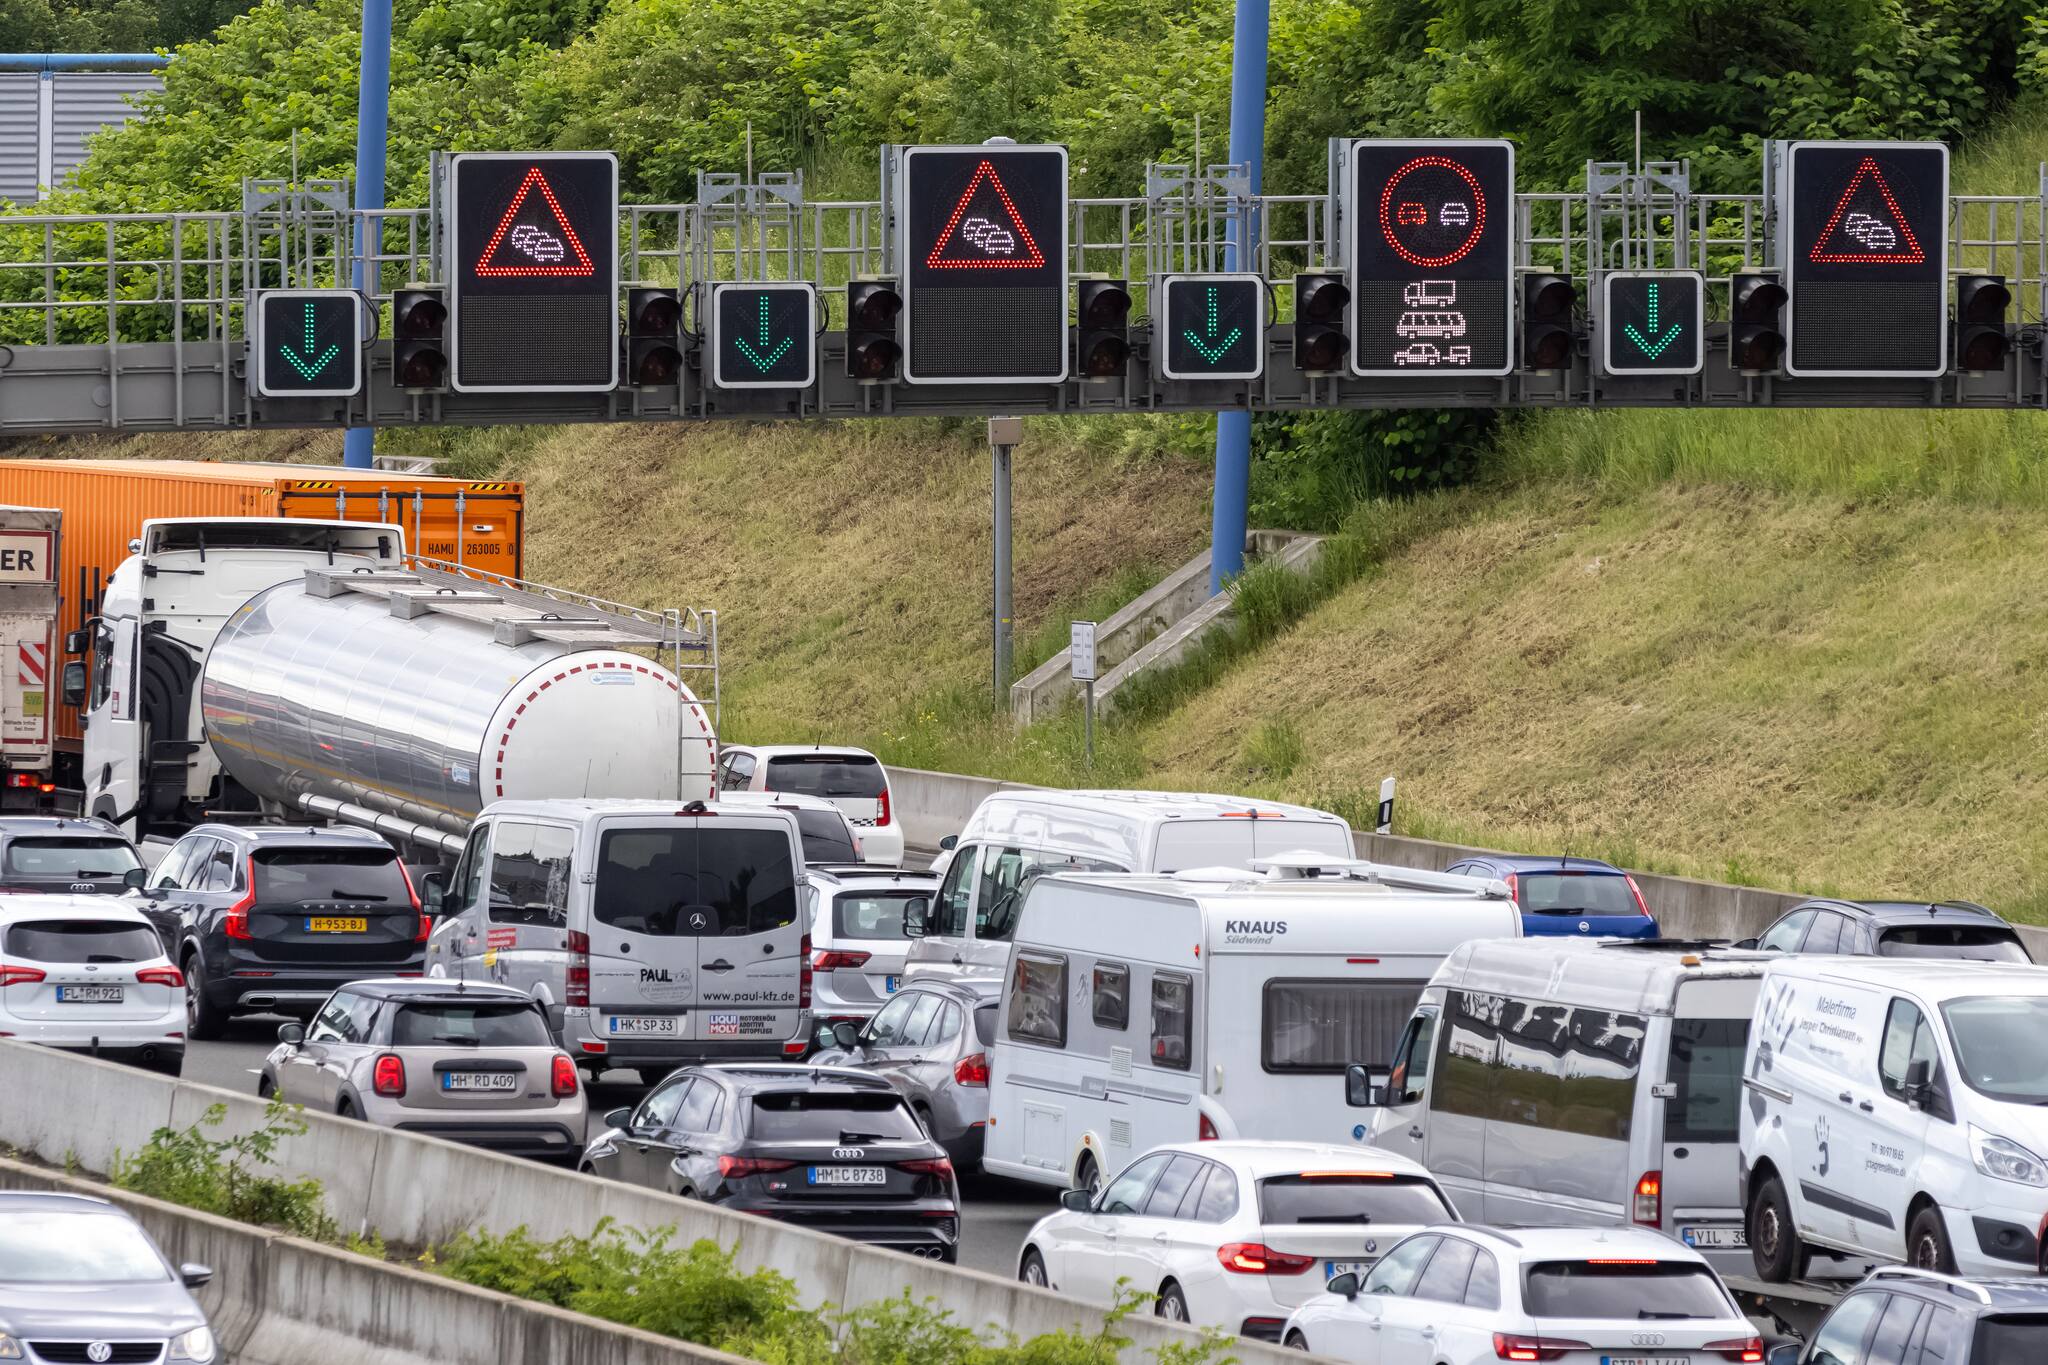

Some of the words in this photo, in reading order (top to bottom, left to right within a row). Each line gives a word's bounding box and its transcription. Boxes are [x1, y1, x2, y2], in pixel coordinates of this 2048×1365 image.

[428, 543, 454, 555] HAMU
[467, 543, 500, 555] 263005
[1, 549, 35, 571] ER
[314, 919, 363, 929] H-953-BJ
[1225, 920, 1288, 934] KNAUS
[1224, 935, 1274, 944] Südwind
[640, 968, 673, 982] PAUL
[64, 988, 79, 999] FL
[102, 988, 122, 999] 921
[703, 991, 795, 1003] www.paul-kfz.de
[1816, 995, 1857, 1020] Malerfirma
[621, 1019, 636, 1030] HK
[643, 1019, 657, 1031] SP
[659, 1020, 673, 1031] 33
[710, 1015, 737, 1024] LIQUI
[710, 1025, 737, 1033] MOLY
[451, 1075, 467, 1086] HH
[474, 1075, 490, 1087] RD
[493, 1075, 514, 1087] 409
[816, 1169, 834, 1181] HM
[841, 1169, 850, 1181] C
[853, 1169, 884, 1181] 8738
[1695, 1230, 1722, 1244] YIL
